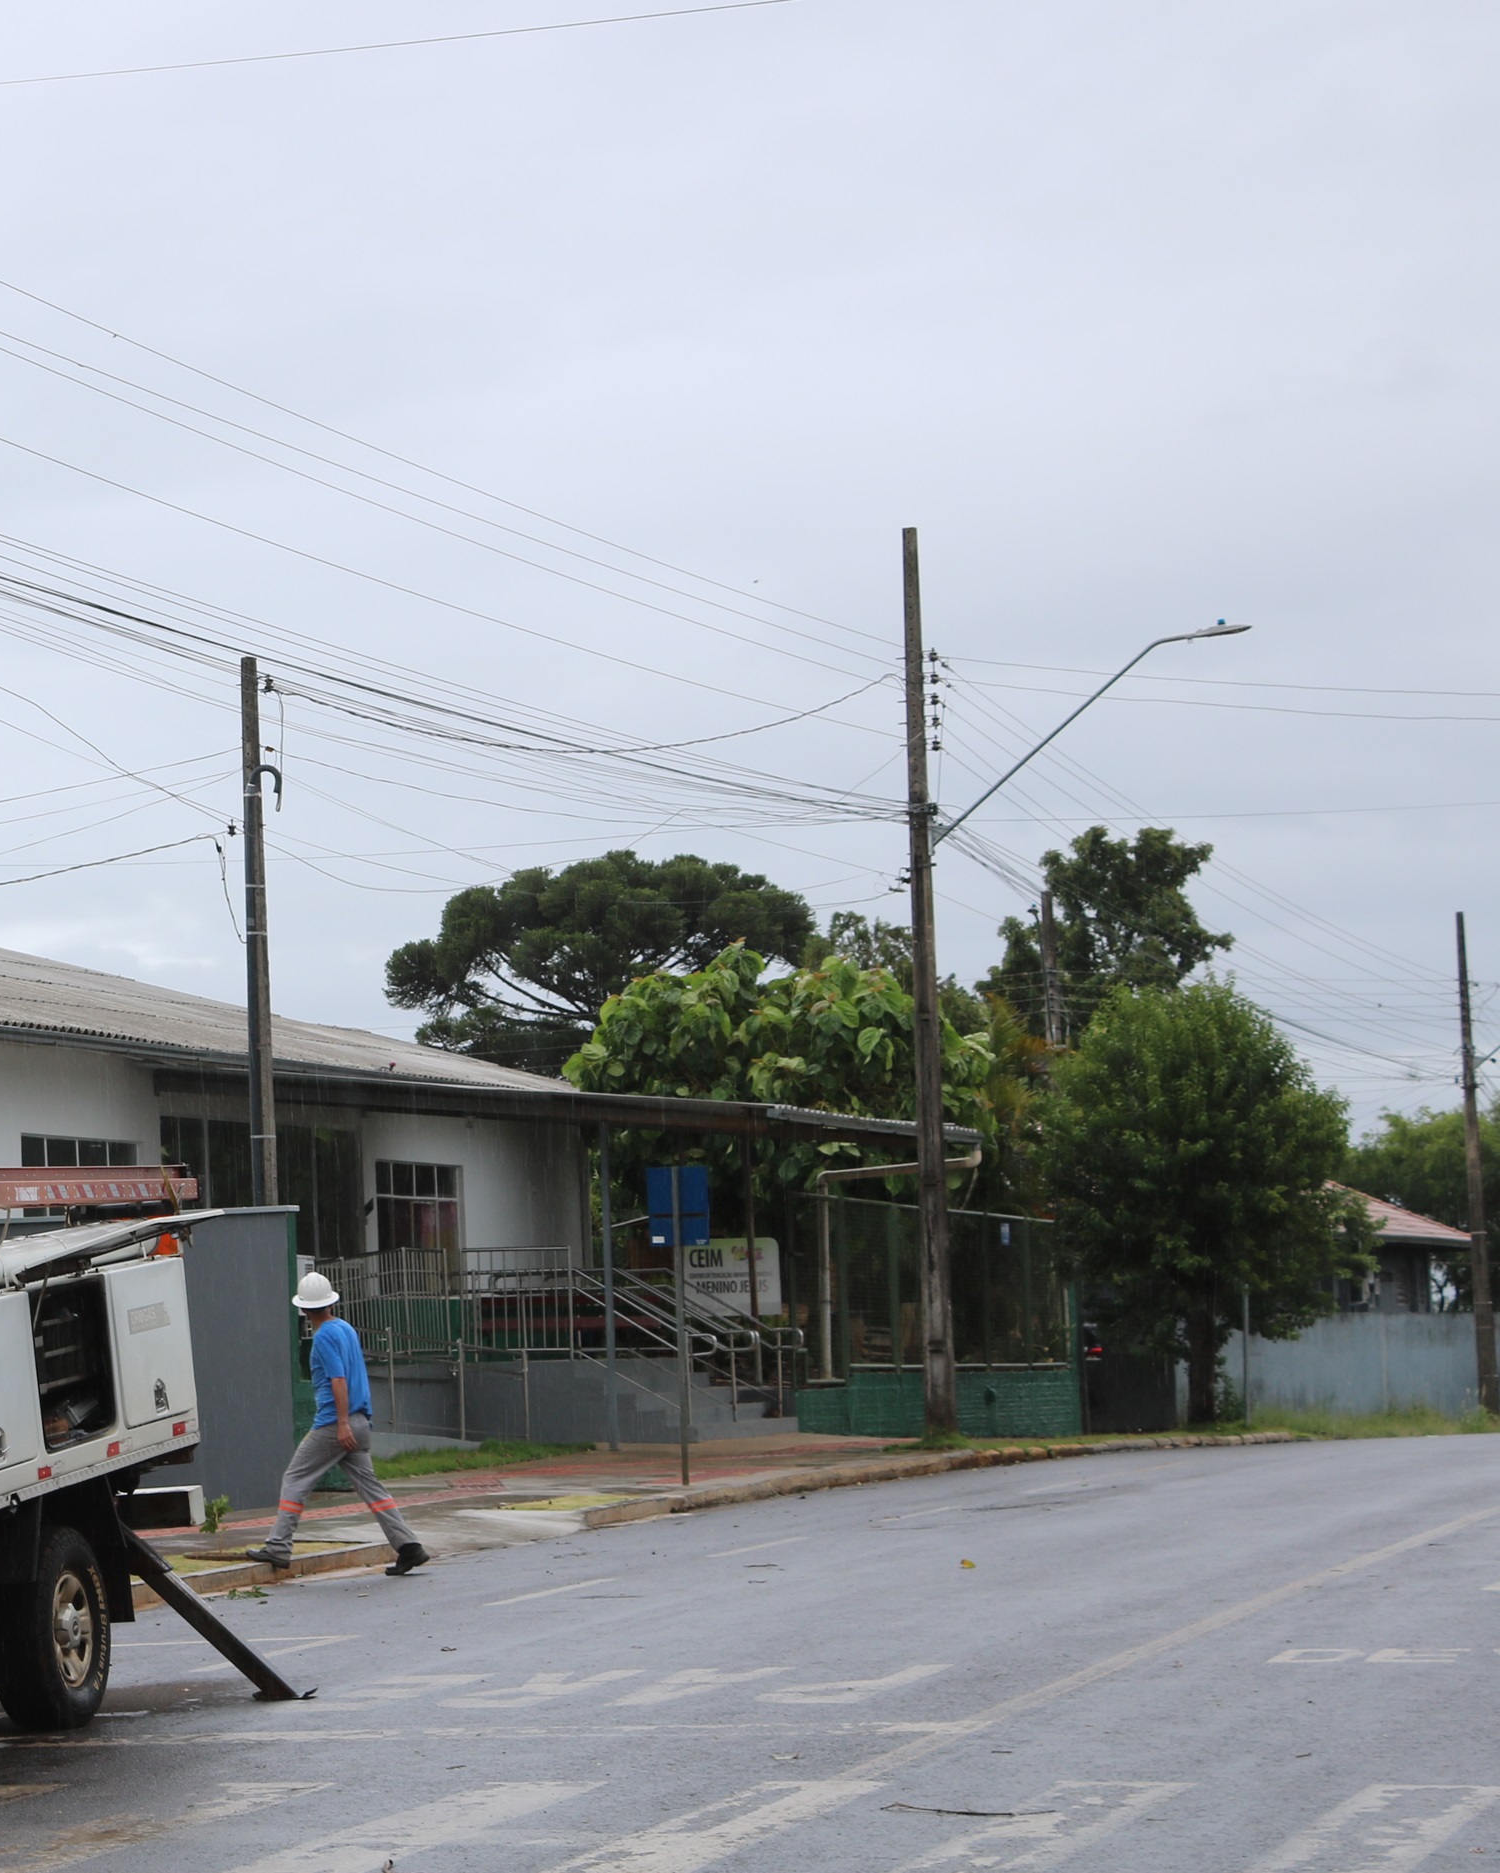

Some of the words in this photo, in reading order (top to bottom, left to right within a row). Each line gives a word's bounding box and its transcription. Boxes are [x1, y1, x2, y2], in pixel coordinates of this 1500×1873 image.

[688, 1248, 724, 1268] CEIM
[696, 1280, 738, 1294] MENINO
[739, 1280, 768, 1293] JEUS
